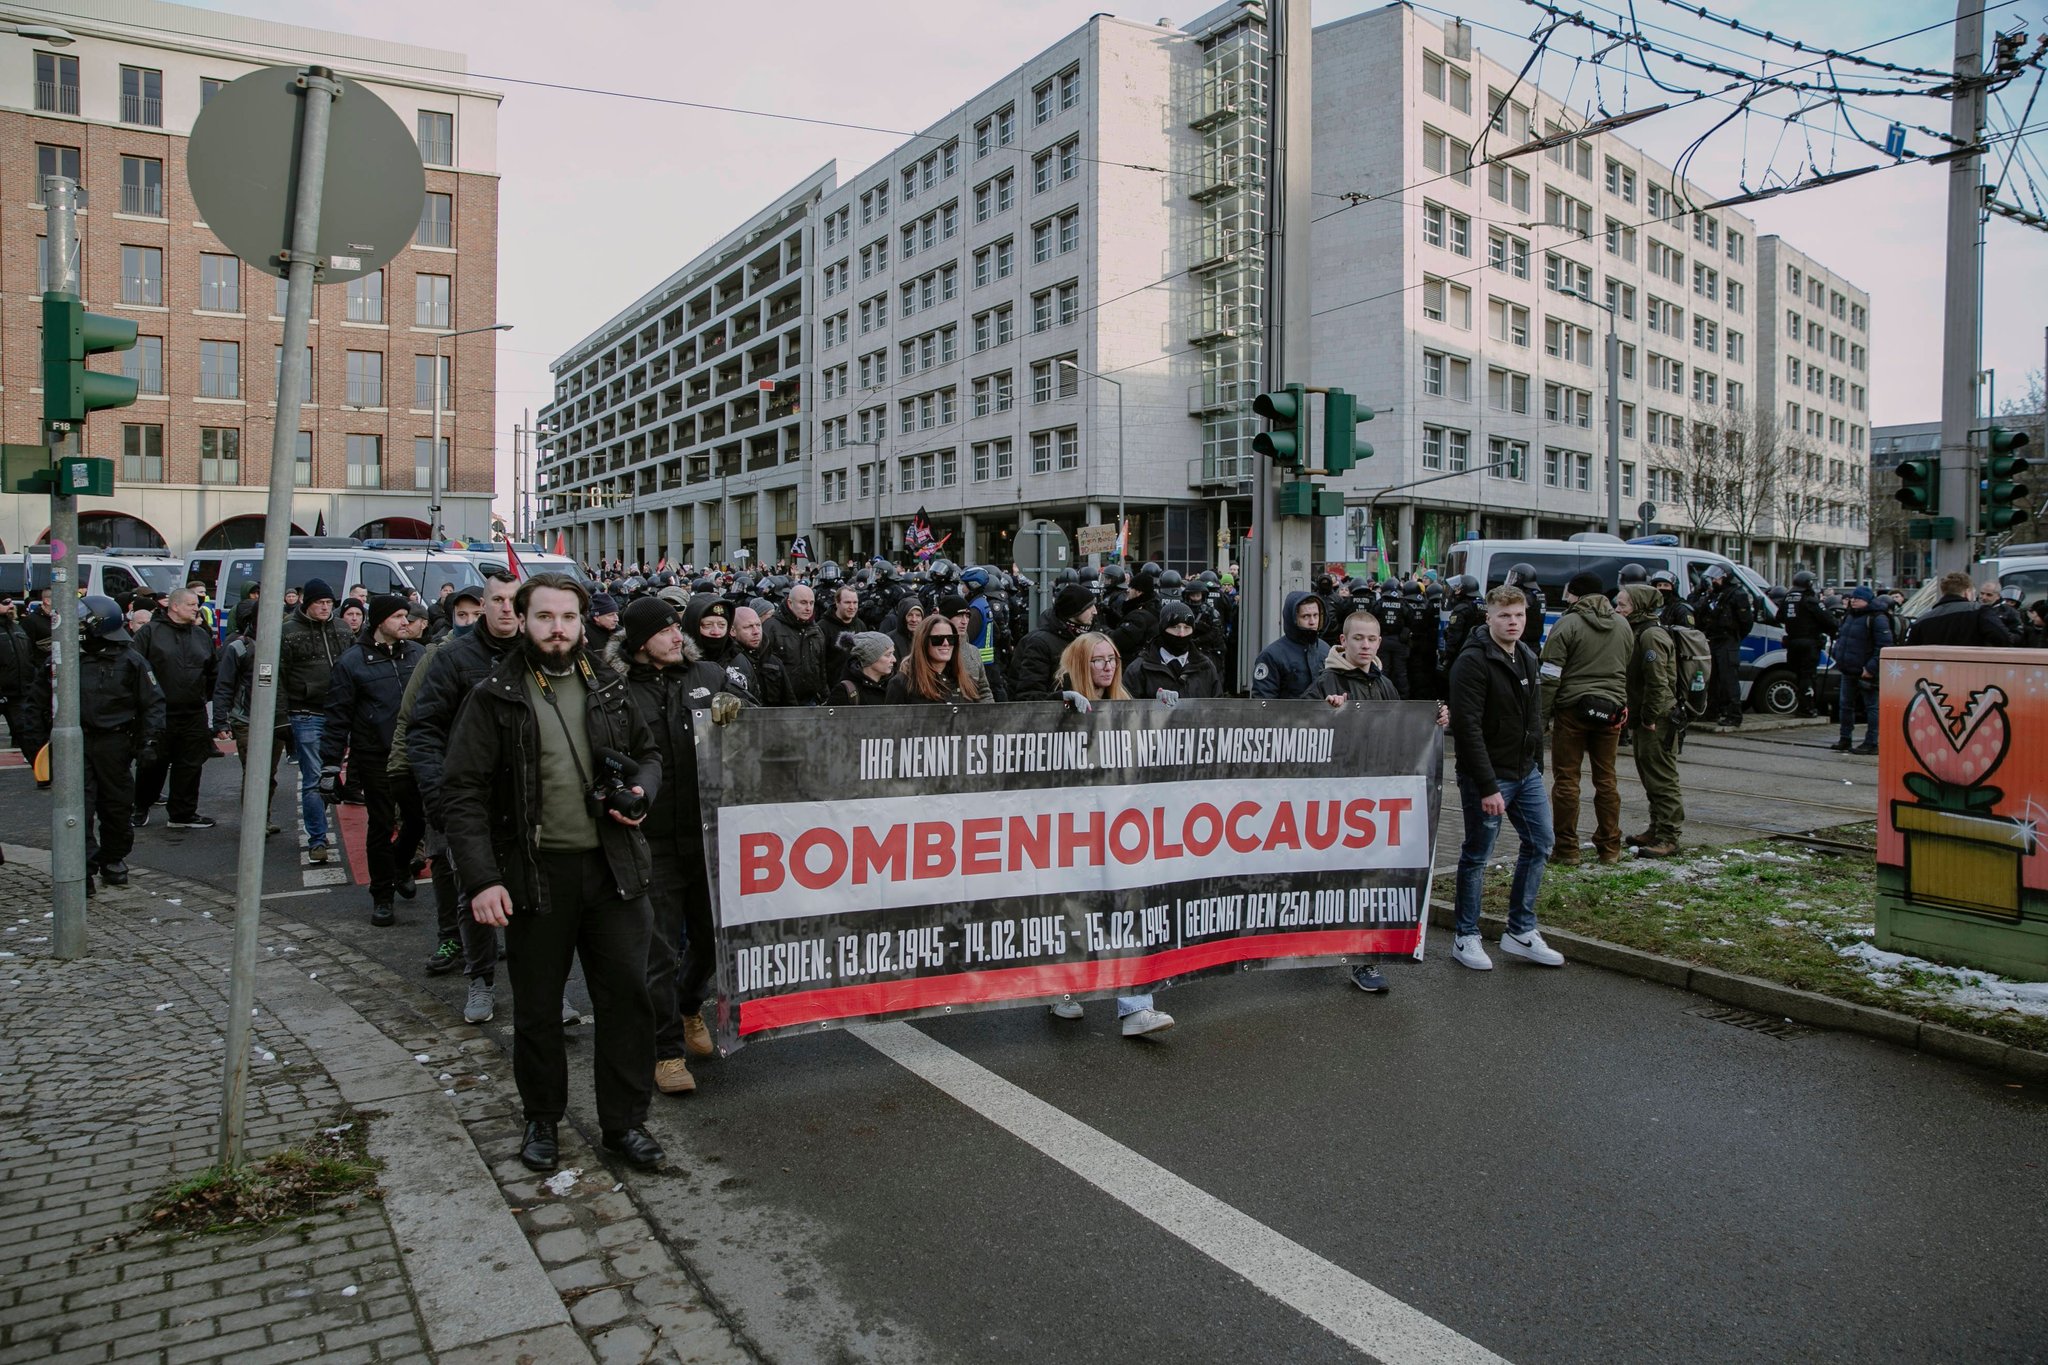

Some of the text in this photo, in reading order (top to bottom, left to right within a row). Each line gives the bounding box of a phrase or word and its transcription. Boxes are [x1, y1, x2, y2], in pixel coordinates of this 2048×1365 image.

[52, 422, 71, 431] F18
[1382, 601, 1401, 609] POLIZEI
[1595, 711, 1609, 720] IFAK
[860, 727, 1335, 780] IHR NENNT ES BEFREIUNG. WIR NENNEN ES MASSENMORD!
[739, 797, 1412, 896] BOMBENHOLOCAUST
[737, 938, 832, 993] DRESDEN:
[838, 926, 944, 978] 13.02.1945
[964, 915, 1066, 963] 14.02.1945
[1085, 905, 1170, 952] 15.02.1945
[1185, 894, 1244, 938] GEDENKT
[1247, 892, 1277, 929] DEN
[1279, 889, 1345, 927] 250.000
[1349, 887, 1418, 923] OPFERN!
